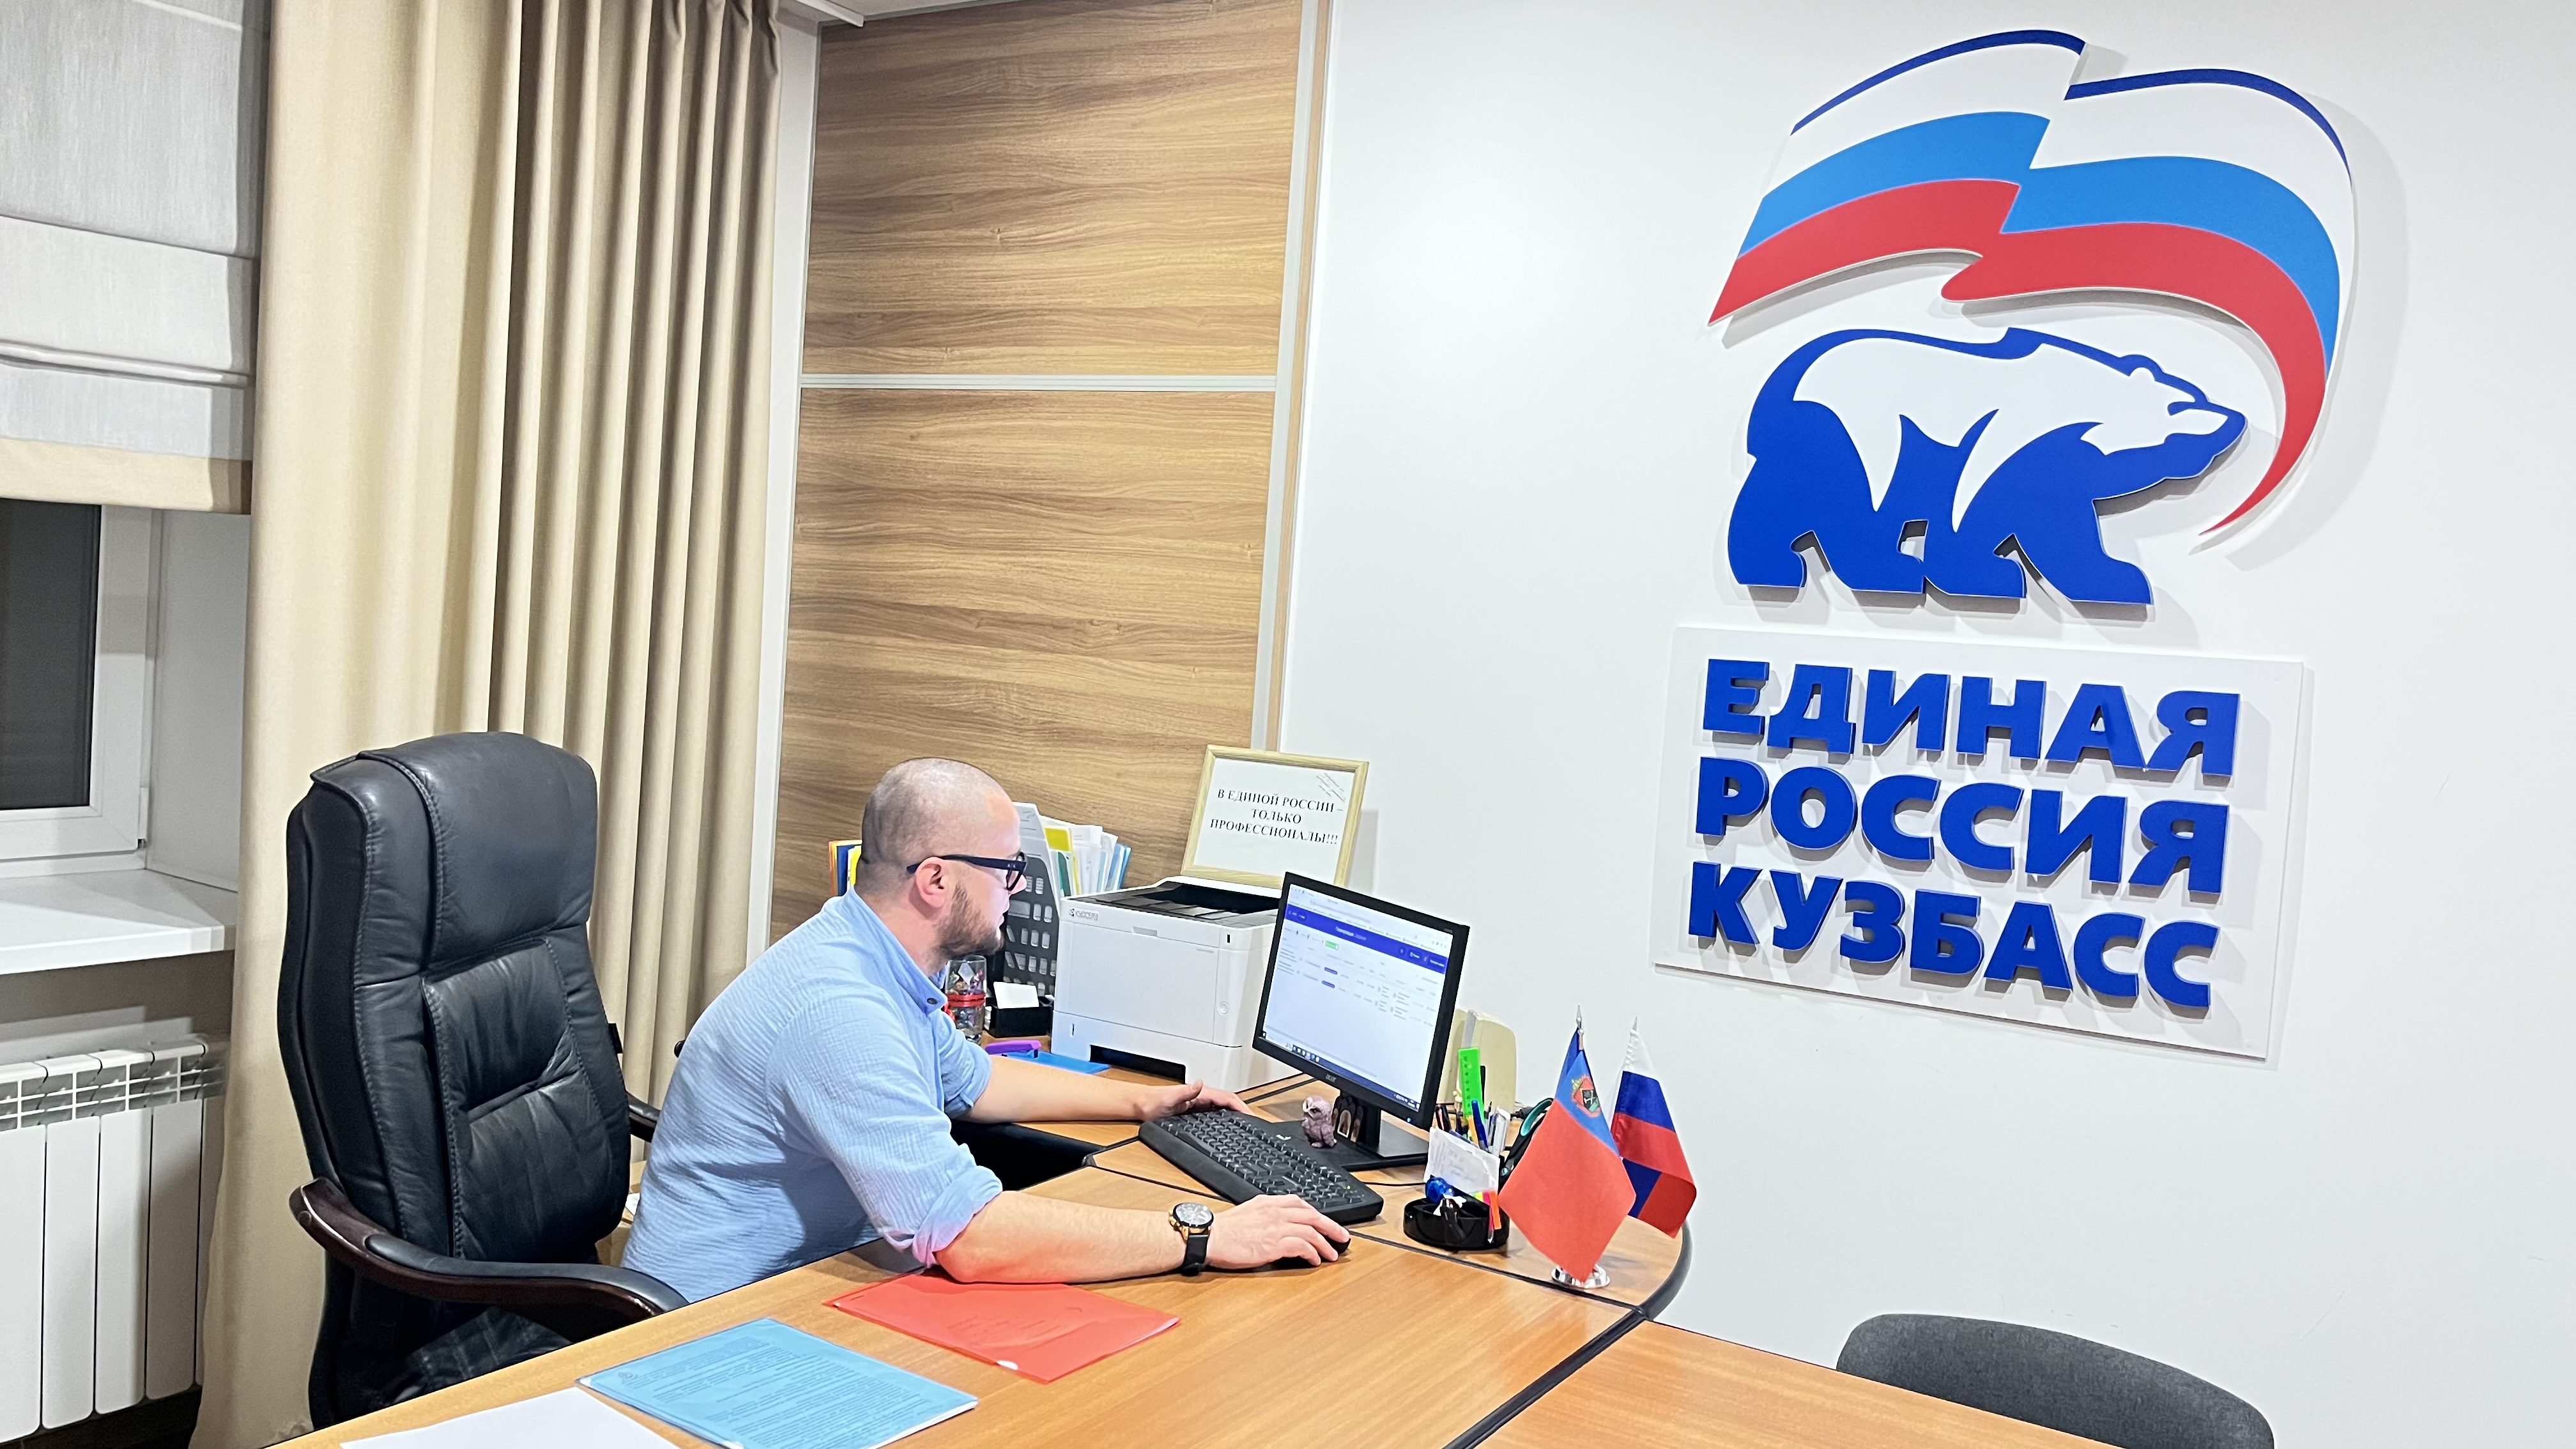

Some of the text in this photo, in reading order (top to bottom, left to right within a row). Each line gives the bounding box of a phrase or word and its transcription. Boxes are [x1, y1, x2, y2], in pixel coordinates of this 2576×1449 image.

[1703, 658, 2239, 776] ЕДИНАЯ
[1217, 788, 1225, 799] В
[1228, 790, 1279, 806] ЕДИНОЙ
[1282, 797, 1335, 813] РОССИИ
[1251, 808, 1302, 825] ТОЛЬКО
[1695, 756, 2229, 894] РОССИЯ
[1210, 818, 1338, 845] ПРОФЕССИОНАЛЫ!!!
[1688, 861, 2220, 1008] КУЗБАСС
[1325, 1073, 1337, 1083] acer
